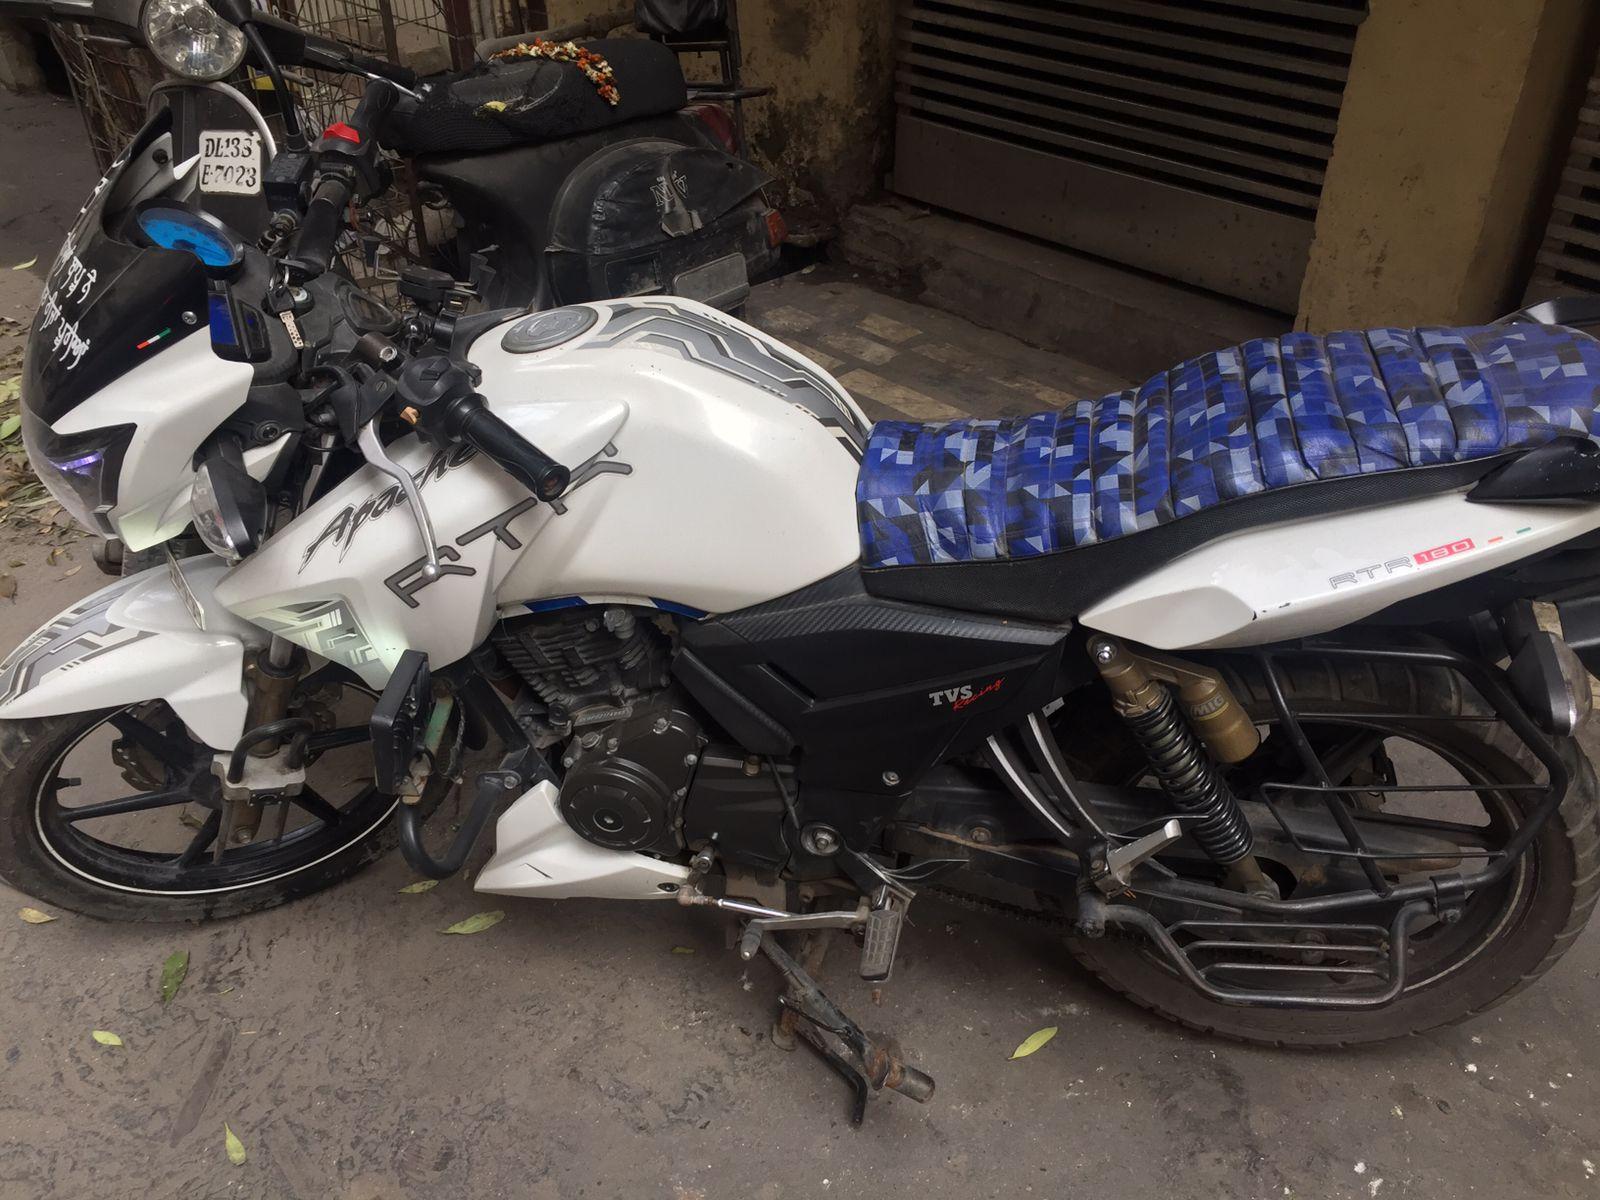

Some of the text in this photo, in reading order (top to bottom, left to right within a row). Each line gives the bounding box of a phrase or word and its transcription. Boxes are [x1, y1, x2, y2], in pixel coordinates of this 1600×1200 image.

[1328, 540, 1472, 590] RTR 180
[928, 684, 974, 707] TVS
